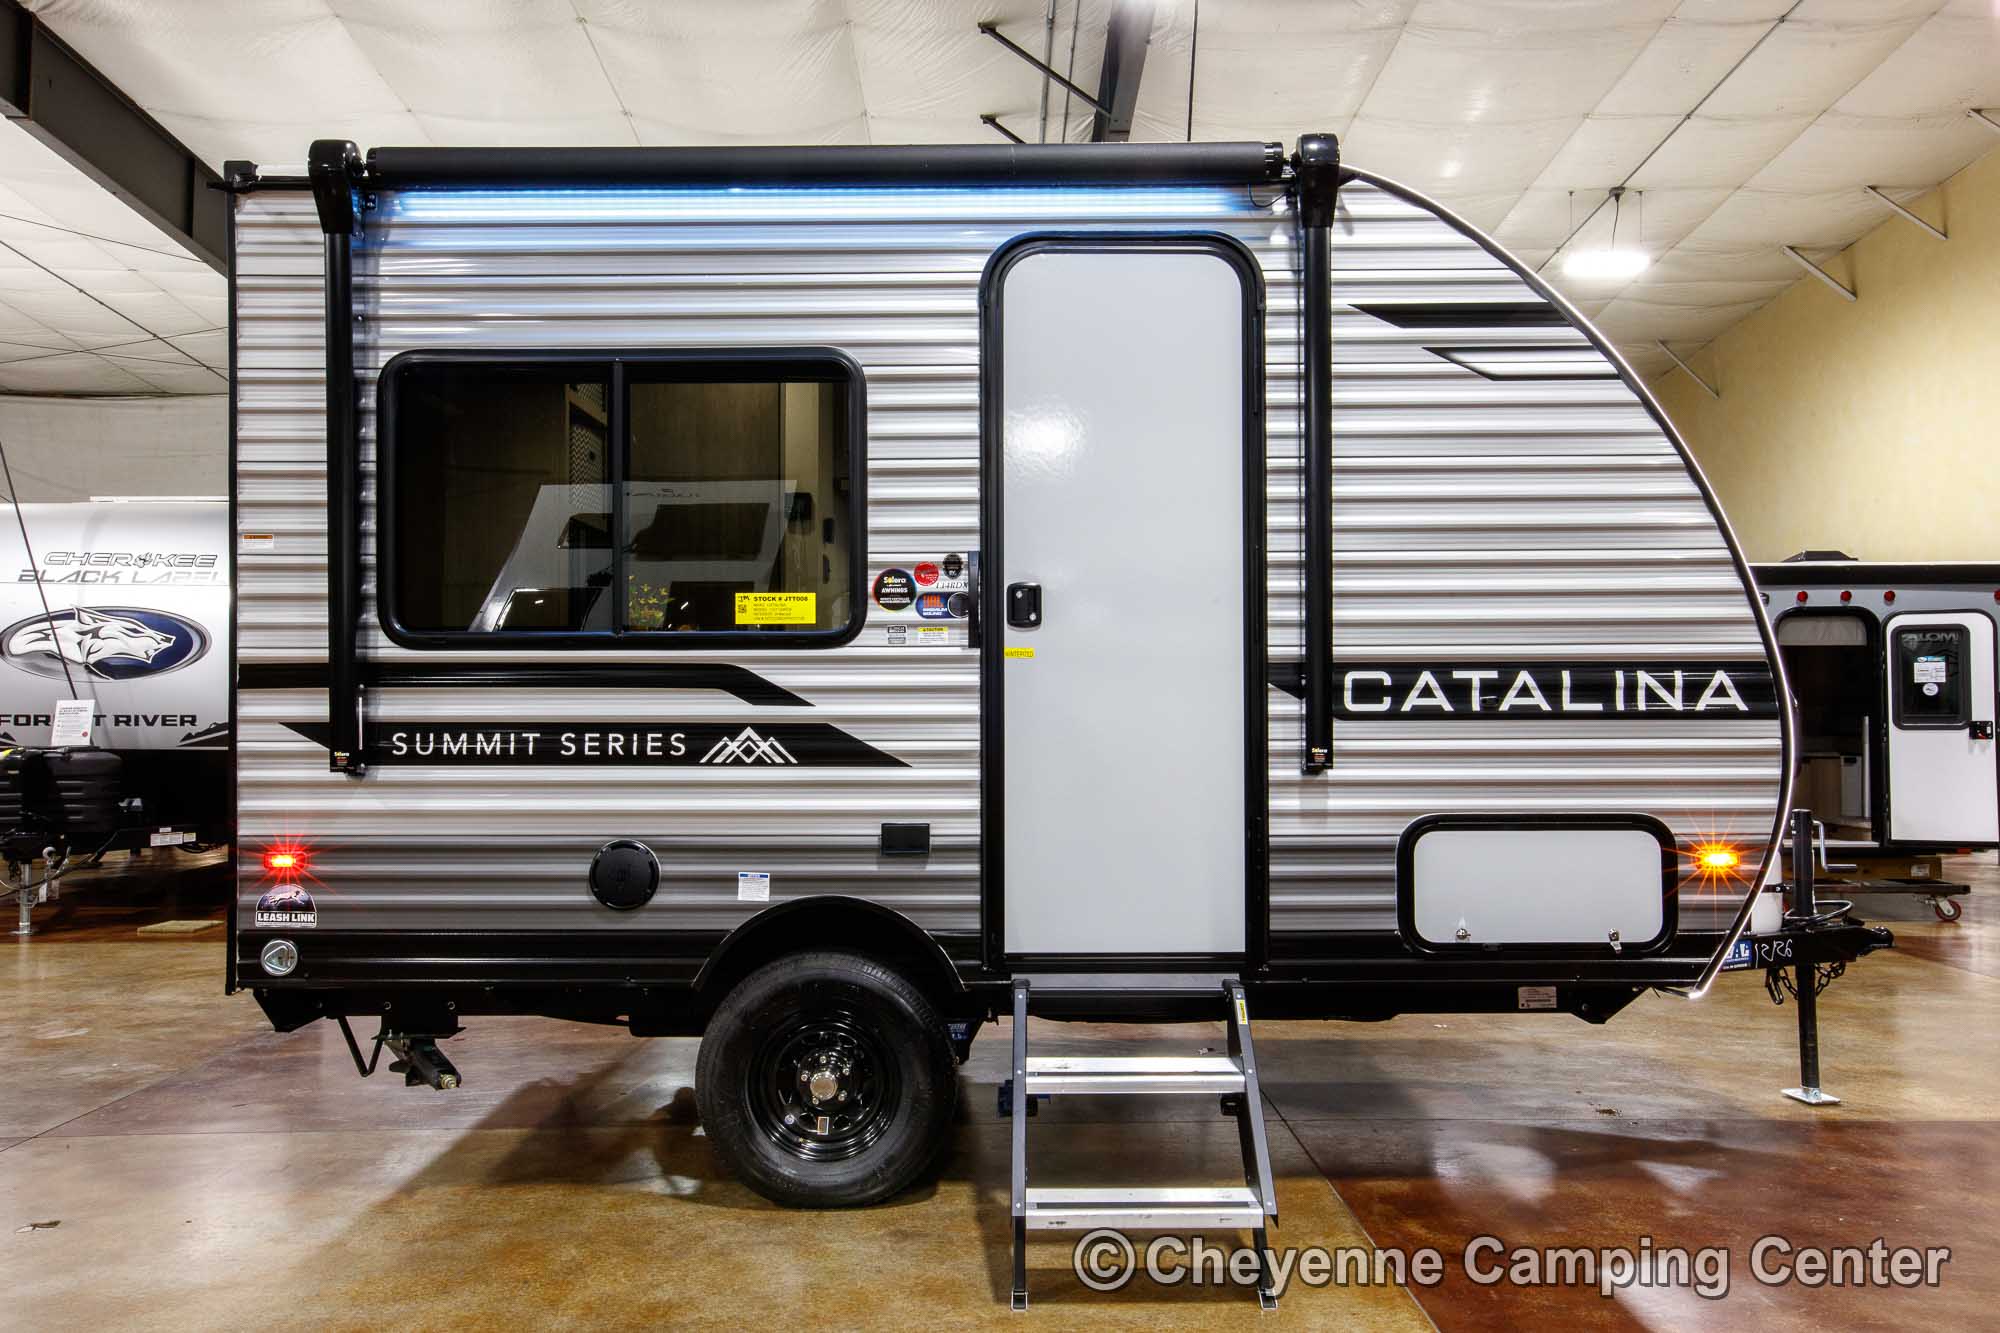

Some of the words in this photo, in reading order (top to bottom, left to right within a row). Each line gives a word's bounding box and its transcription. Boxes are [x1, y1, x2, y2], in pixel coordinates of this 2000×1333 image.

[43, 550, 218, 568] CHEROKEE
[17, 569, 121, 583] BLACK
[1344, 670, 1749, 712] CATALINA
[0, 713, 107, 727] FORT
[114, 714, 198, 727] RIVER
[391, 732, 541, 755] SUMMIT
[560, 732, 687, 756] SERIES
[257, 912, 290, 922] LEASH
[291, 912, 315, 922] LINK
